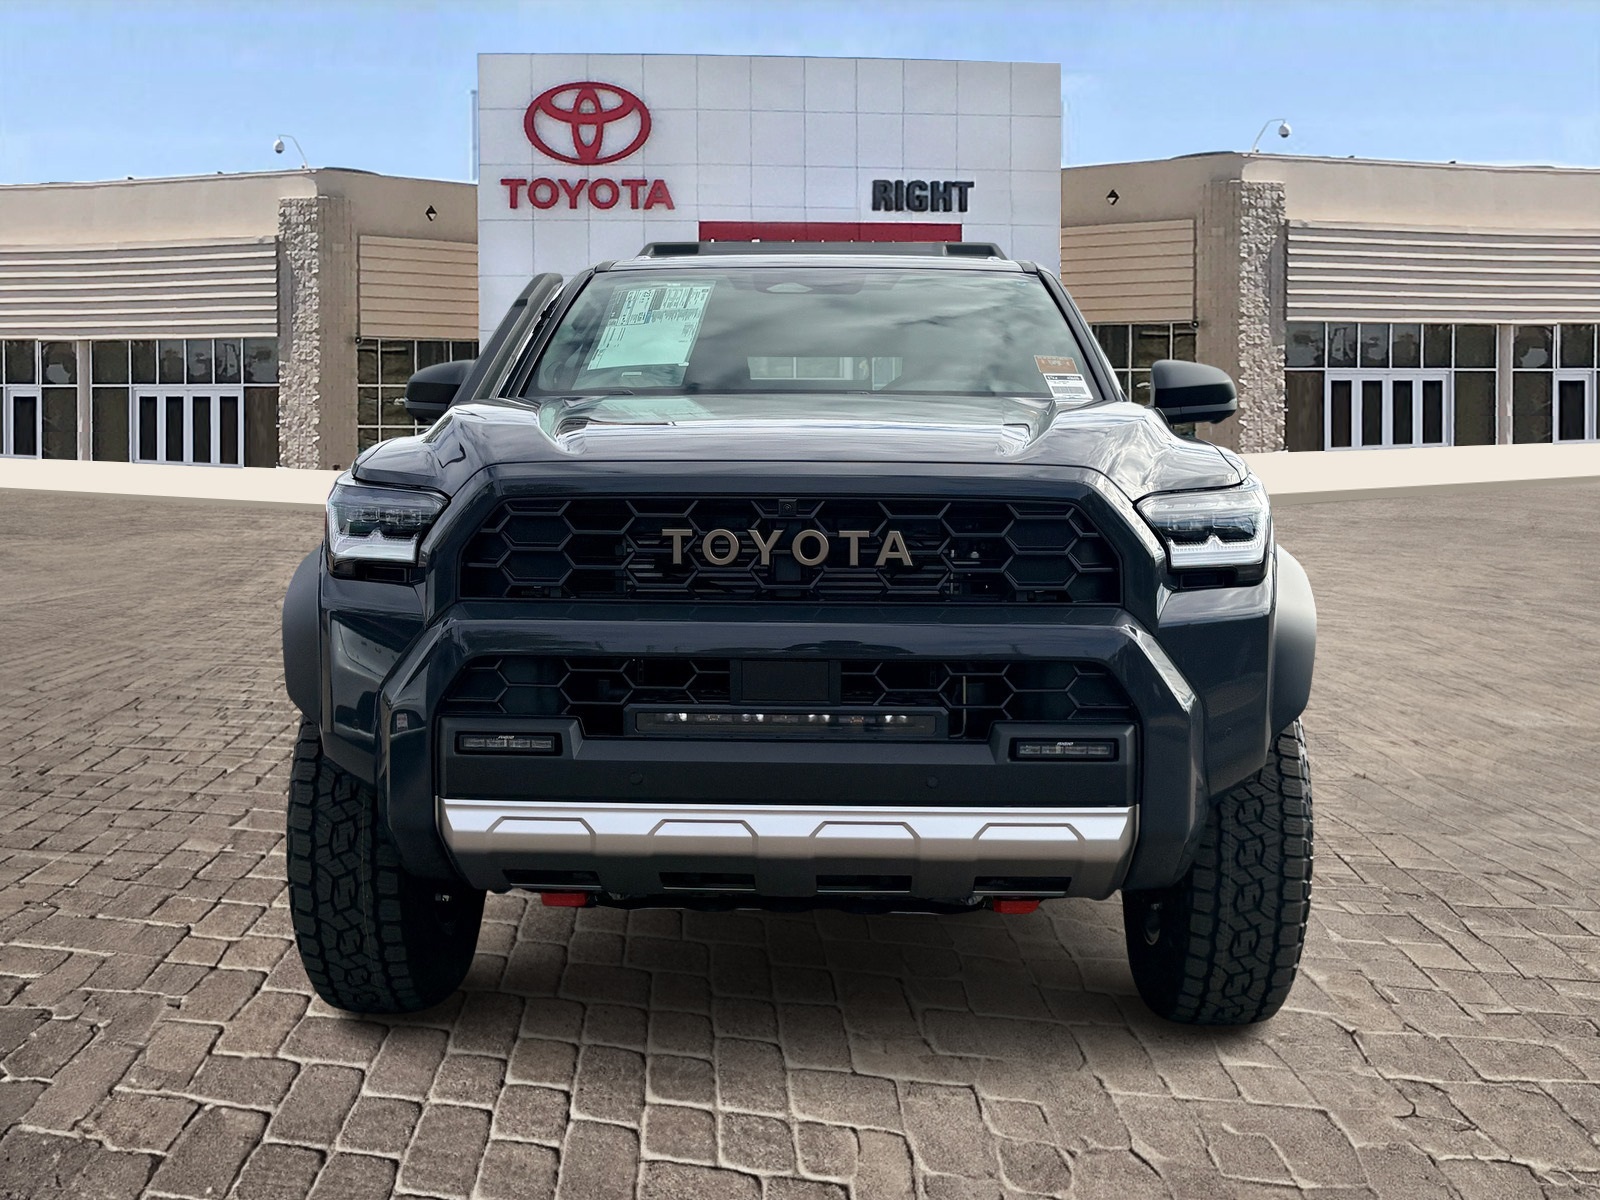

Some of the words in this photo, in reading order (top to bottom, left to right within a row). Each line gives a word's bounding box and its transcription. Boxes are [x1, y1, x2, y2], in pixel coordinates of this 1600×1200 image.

[501, 178, 675, 210] TOYOTA
[872, 180, 975, 213] RIGHT
[662, 528, 913, 566] TOYOTA
